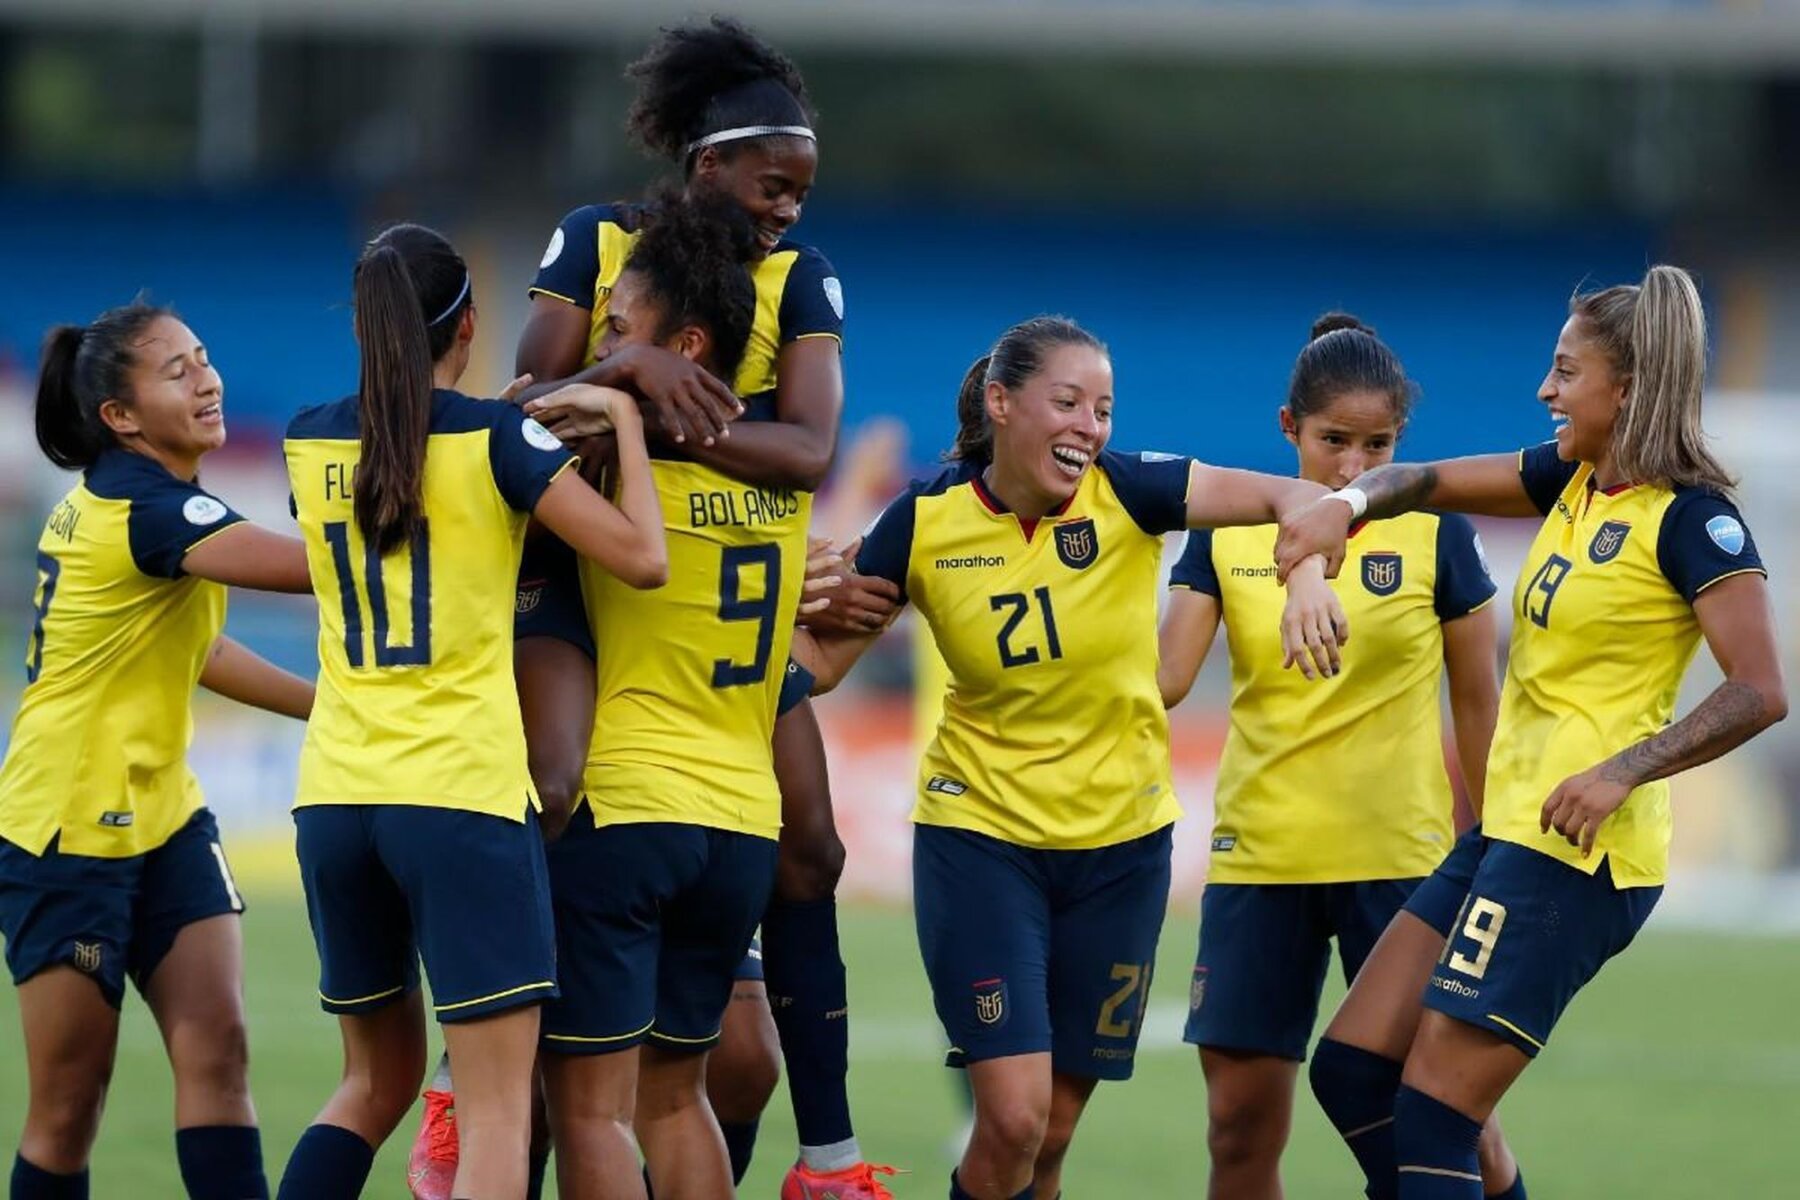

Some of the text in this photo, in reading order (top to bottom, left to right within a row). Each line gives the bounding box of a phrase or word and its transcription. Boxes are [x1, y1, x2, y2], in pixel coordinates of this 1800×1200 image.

[323, 516, 431, 667] 10
[936, 556, 1005, 569] marathon
[1524, 553, 1572, 629] 19
[711, 541, 781, 688] 9
[989, 586, 1063, 669] 21
